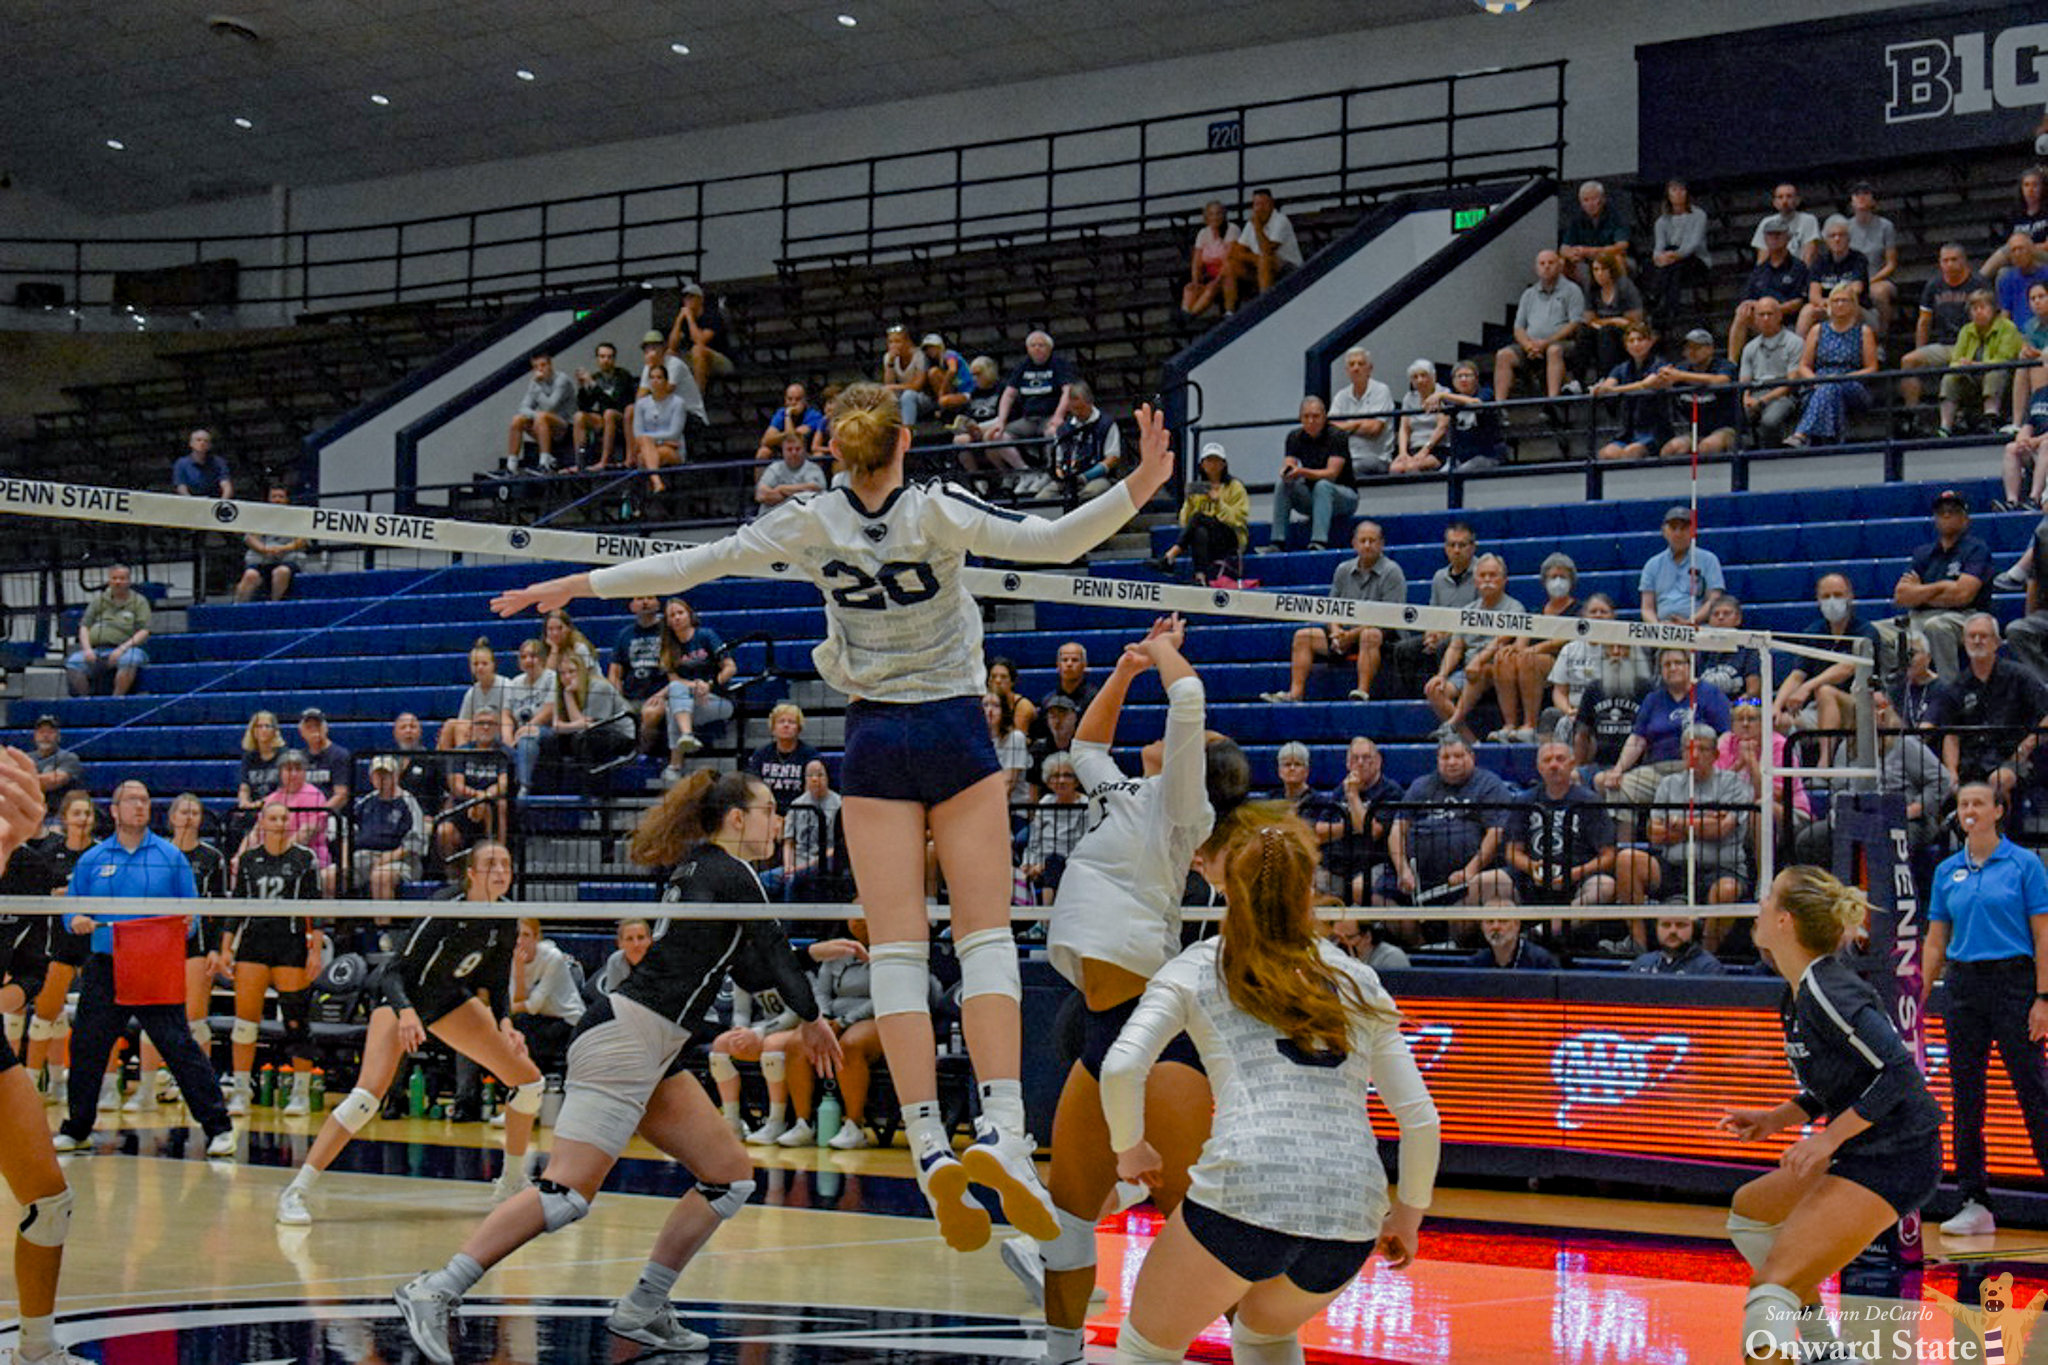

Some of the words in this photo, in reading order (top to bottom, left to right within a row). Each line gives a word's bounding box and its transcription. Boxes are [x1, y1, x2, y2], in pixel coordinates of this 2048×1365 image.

[1210, 125, 1240, 149] 220
[61, 486, 131, 512] STATE
[312, 510, 369, 534] PENN
[374, 516, 435, 540] STATE
[595, 535, 647, 558] PENN
[822, 559, 940, 610] 20
[1073, 579, 1113, 598] PENN
[1117, 582, 1161, 601] STATE
[1275, 596, 1313, 613] PENN
[1316, 599, 1356, 617] STATE
[1460, 610, 1495, 628] PENN
[1497, 613, 1533, 630] STATE
[1629, 623, 1659, 640] PENN
[1661, 626, 1696, 643] STATE
[762, 763, 802, 778] PENN
[763, 778, 802, 790] TATE
[256, 876, 284, 900] 12
[1890, 828, 1918, 976] PENN
[758, 992, 785, 1015] 18
